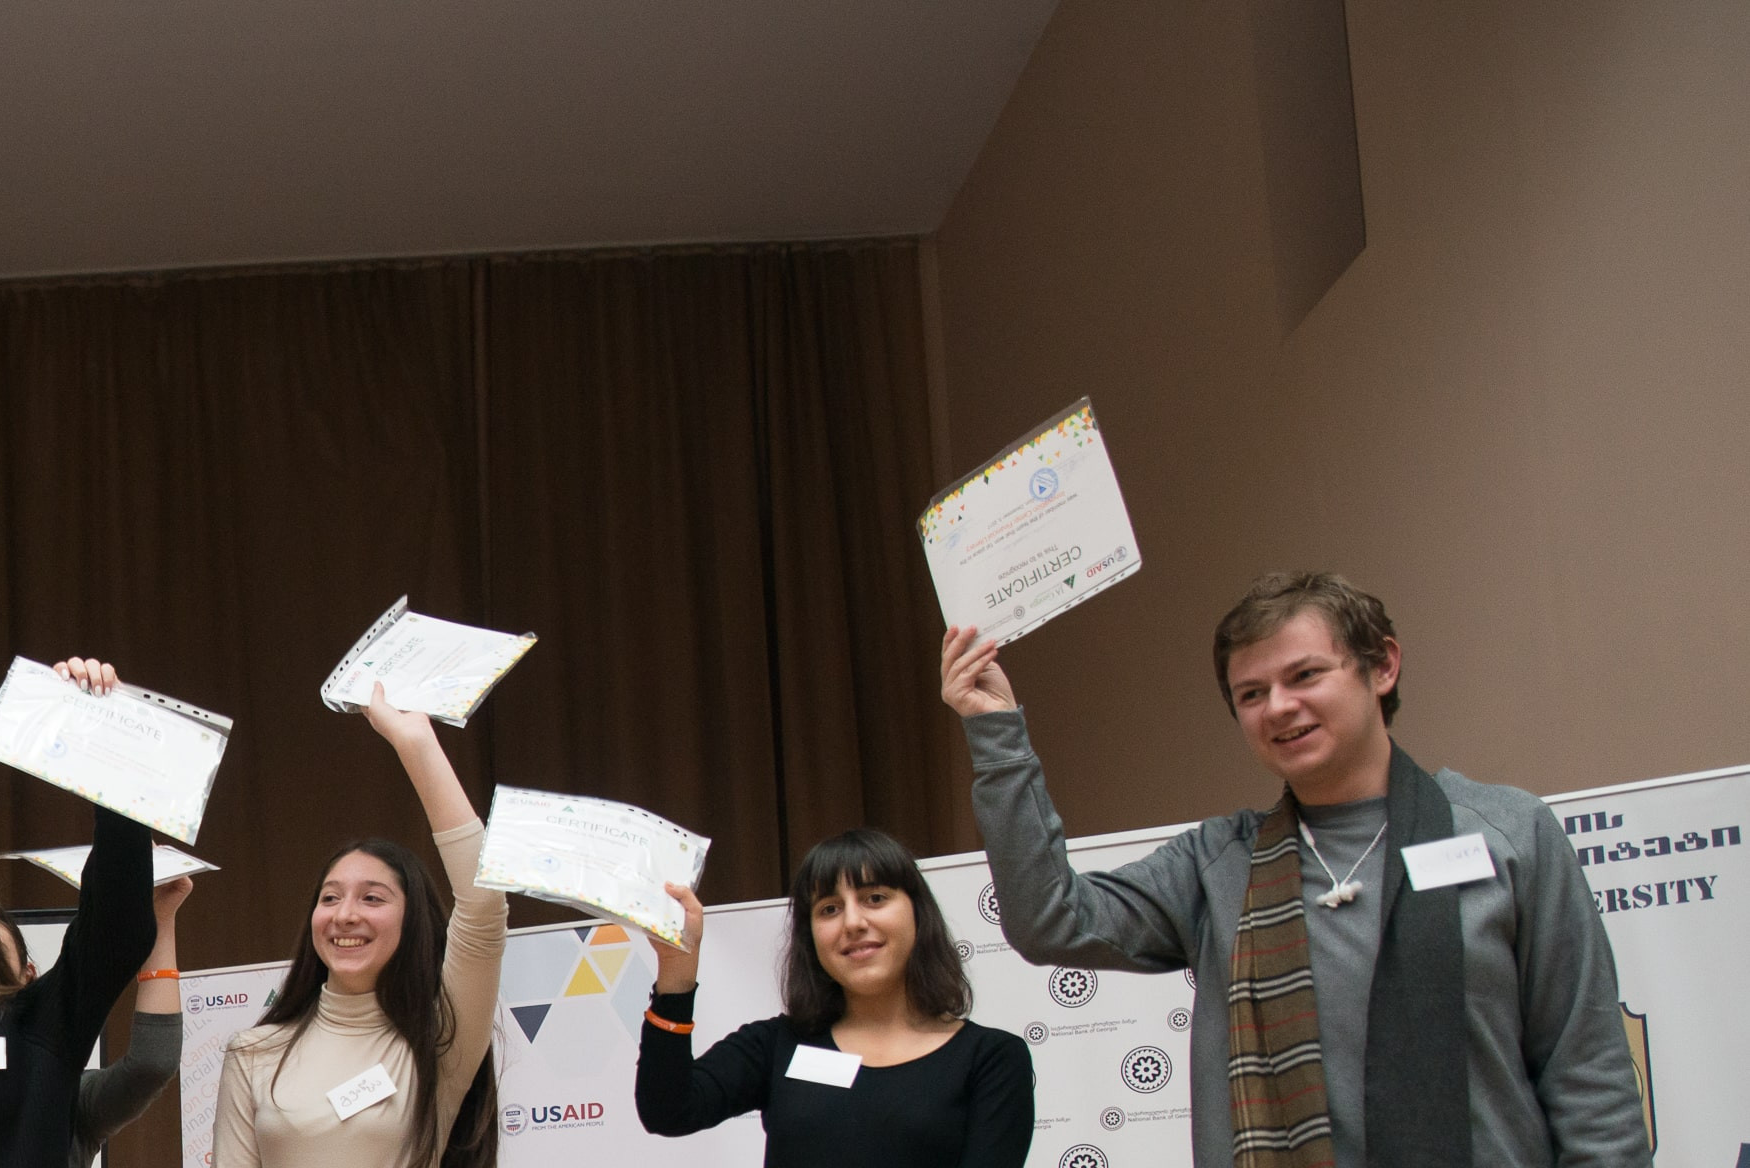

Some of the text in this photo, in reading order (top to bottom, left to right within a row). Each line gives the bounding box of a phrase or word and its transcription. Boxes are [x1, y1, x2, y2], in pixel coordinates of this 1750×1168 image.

[984, 546, 1082, 610] CERTIFICATE
[546, 815, 649, 847] CERTIFICATE
[1564, 811, 1624, 835] ის
[1578, 825, 1742, 867] იტეტი
[1595, 875, 1718, 915] ERSITY
[206, 993, 248, 1007] USAID
[531, 1102, 604, 1123] USAID
